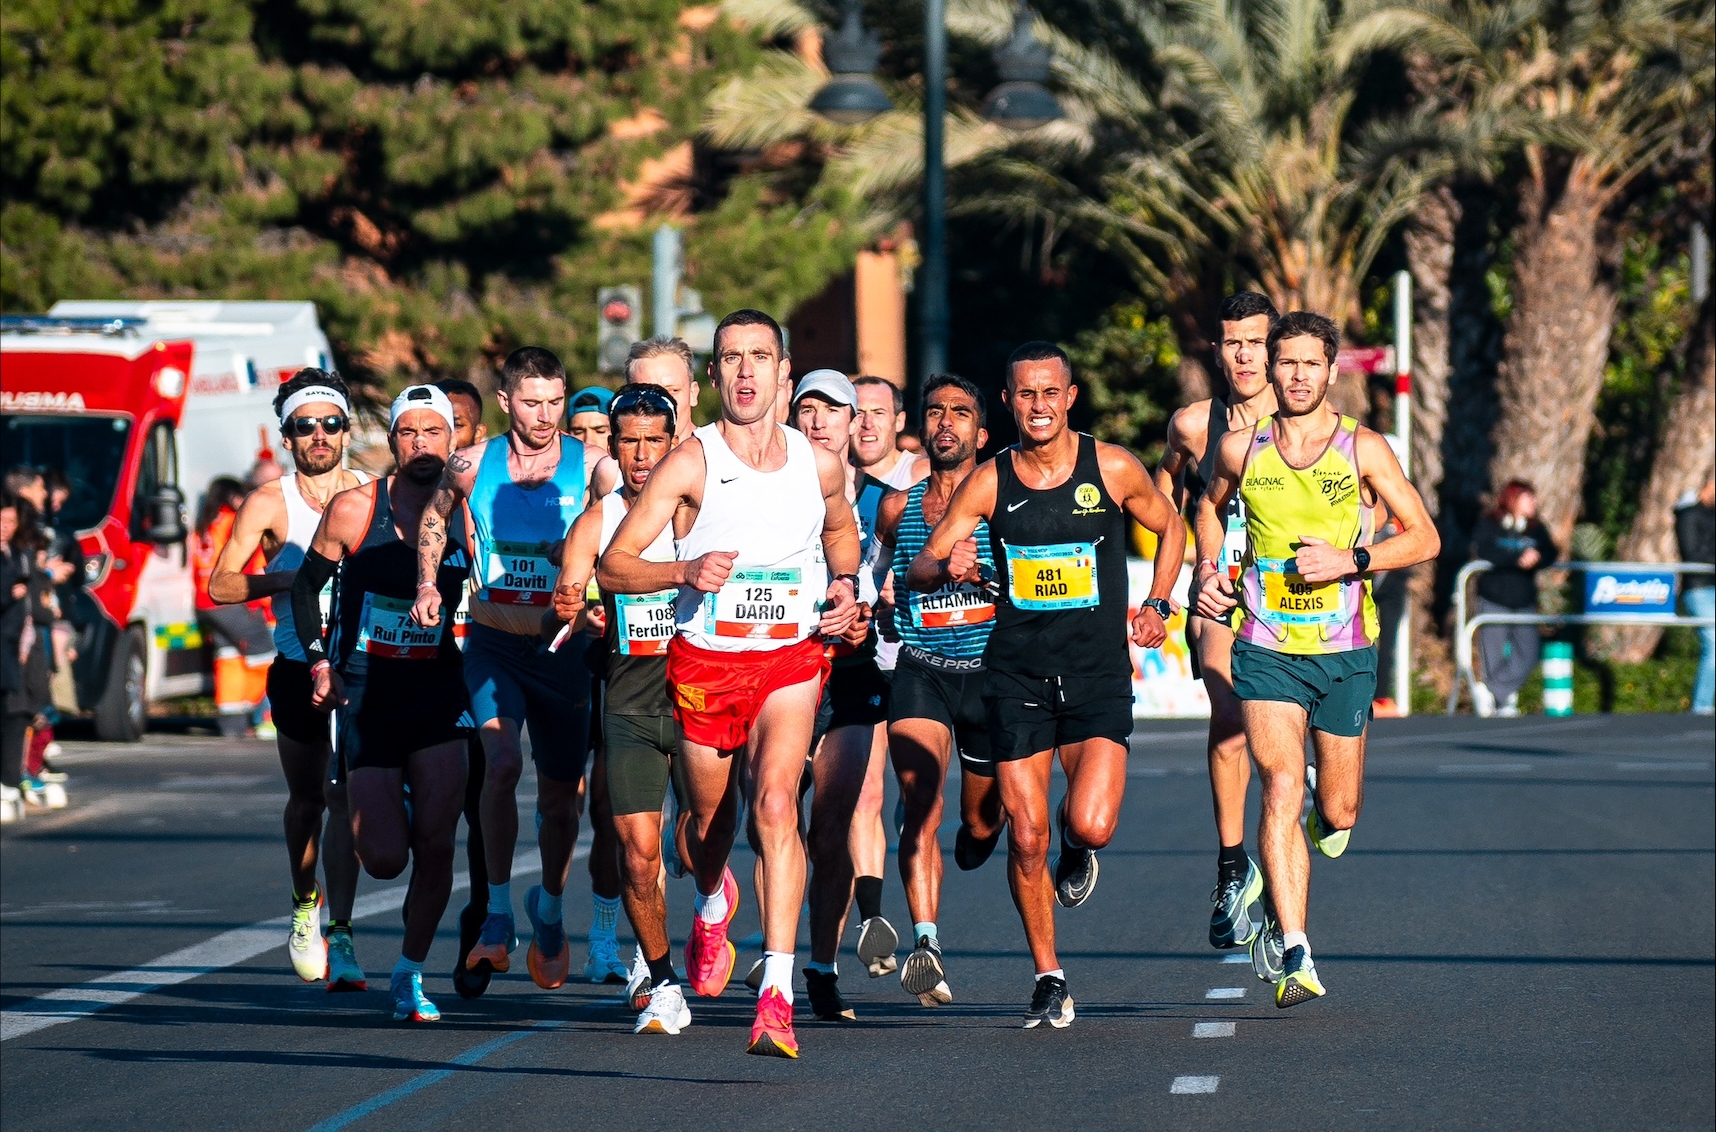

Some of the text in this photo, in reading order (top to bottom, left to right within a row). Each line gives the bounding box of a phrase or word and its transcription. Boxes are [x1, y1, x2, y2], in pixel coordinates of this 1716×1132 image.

[1245, 477, 1285, 486] BLAGNAC
[544, 495, 575, 507] HOKA
[511, 559, 535, 573] 101
[504, 573, 547, 589] Daviti
[1036, 568, 1062, 582] 481
[745, 587, 773, 602] 125
[1035, 583, 1068, 597] RIAD
[1288, 583, 1313, 596] 405
[1280, 597, 1324, 610] ALEXIS
[647, 608, 673, 621] 108
[735, 604, 785, 620] DARIO
[373, 625, 435, 643] Rui Pinto
[904, 645, 982, 670] NIKE PRO
